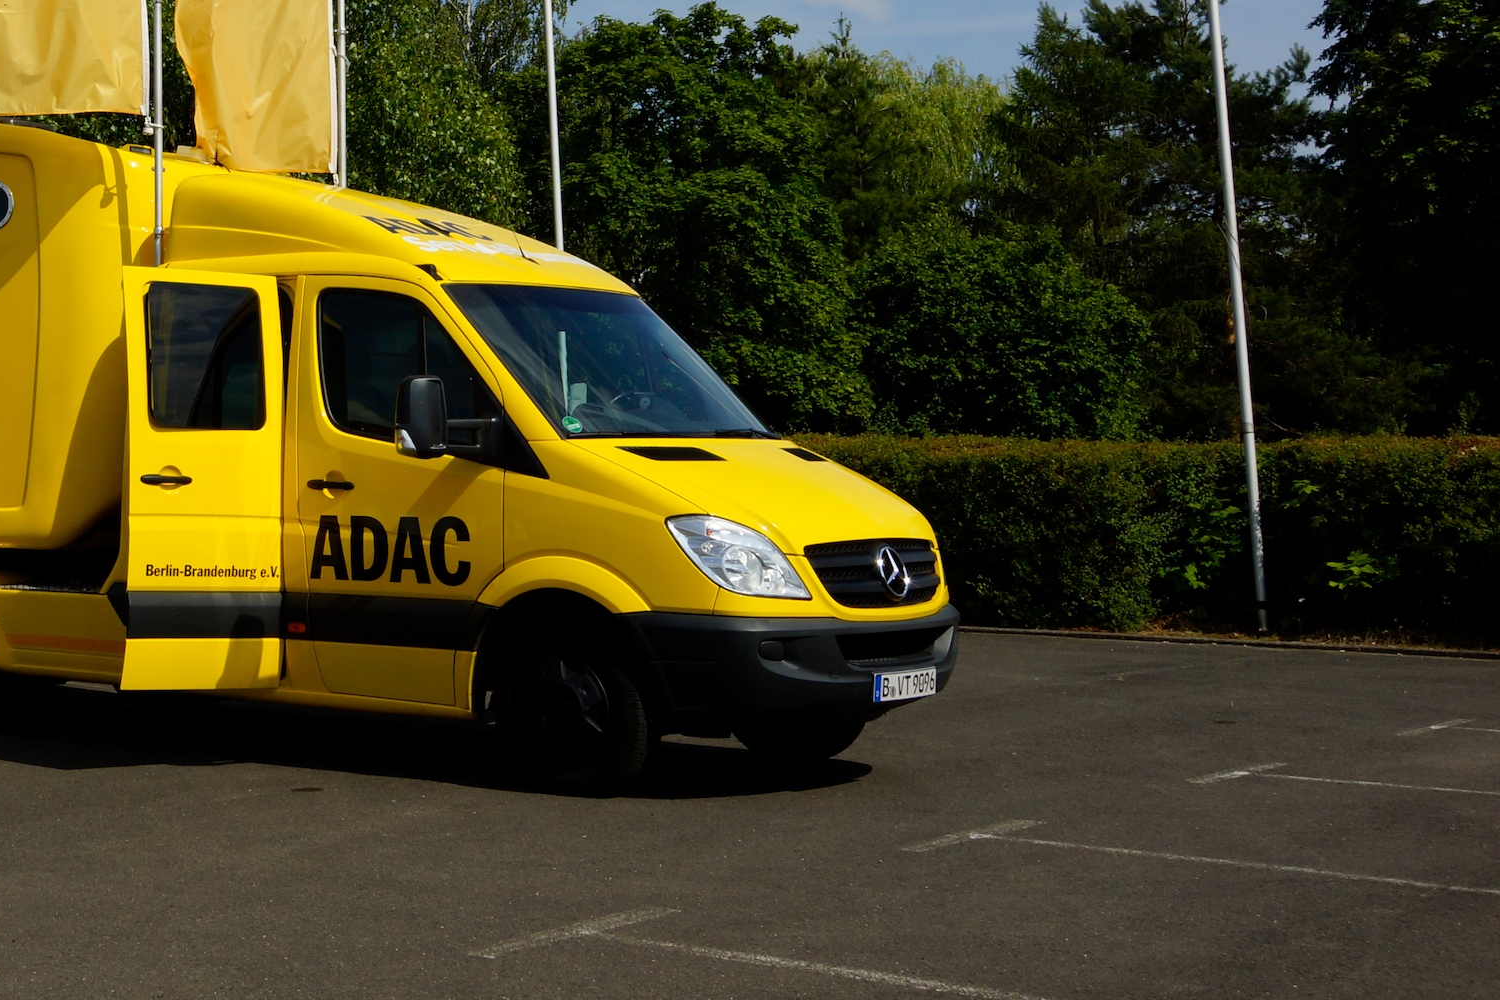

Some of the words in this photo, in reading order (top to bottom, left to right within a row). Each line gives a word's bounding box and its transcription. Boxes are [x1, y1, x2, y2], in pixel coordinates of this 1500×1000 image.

[361, 215, 494, 240] ADAC
[309, 515, 471, 587] ADAC
[145, 564, 257, 580] Berlin-Brandenburg
[260, 565, 280, 578] e.V.
